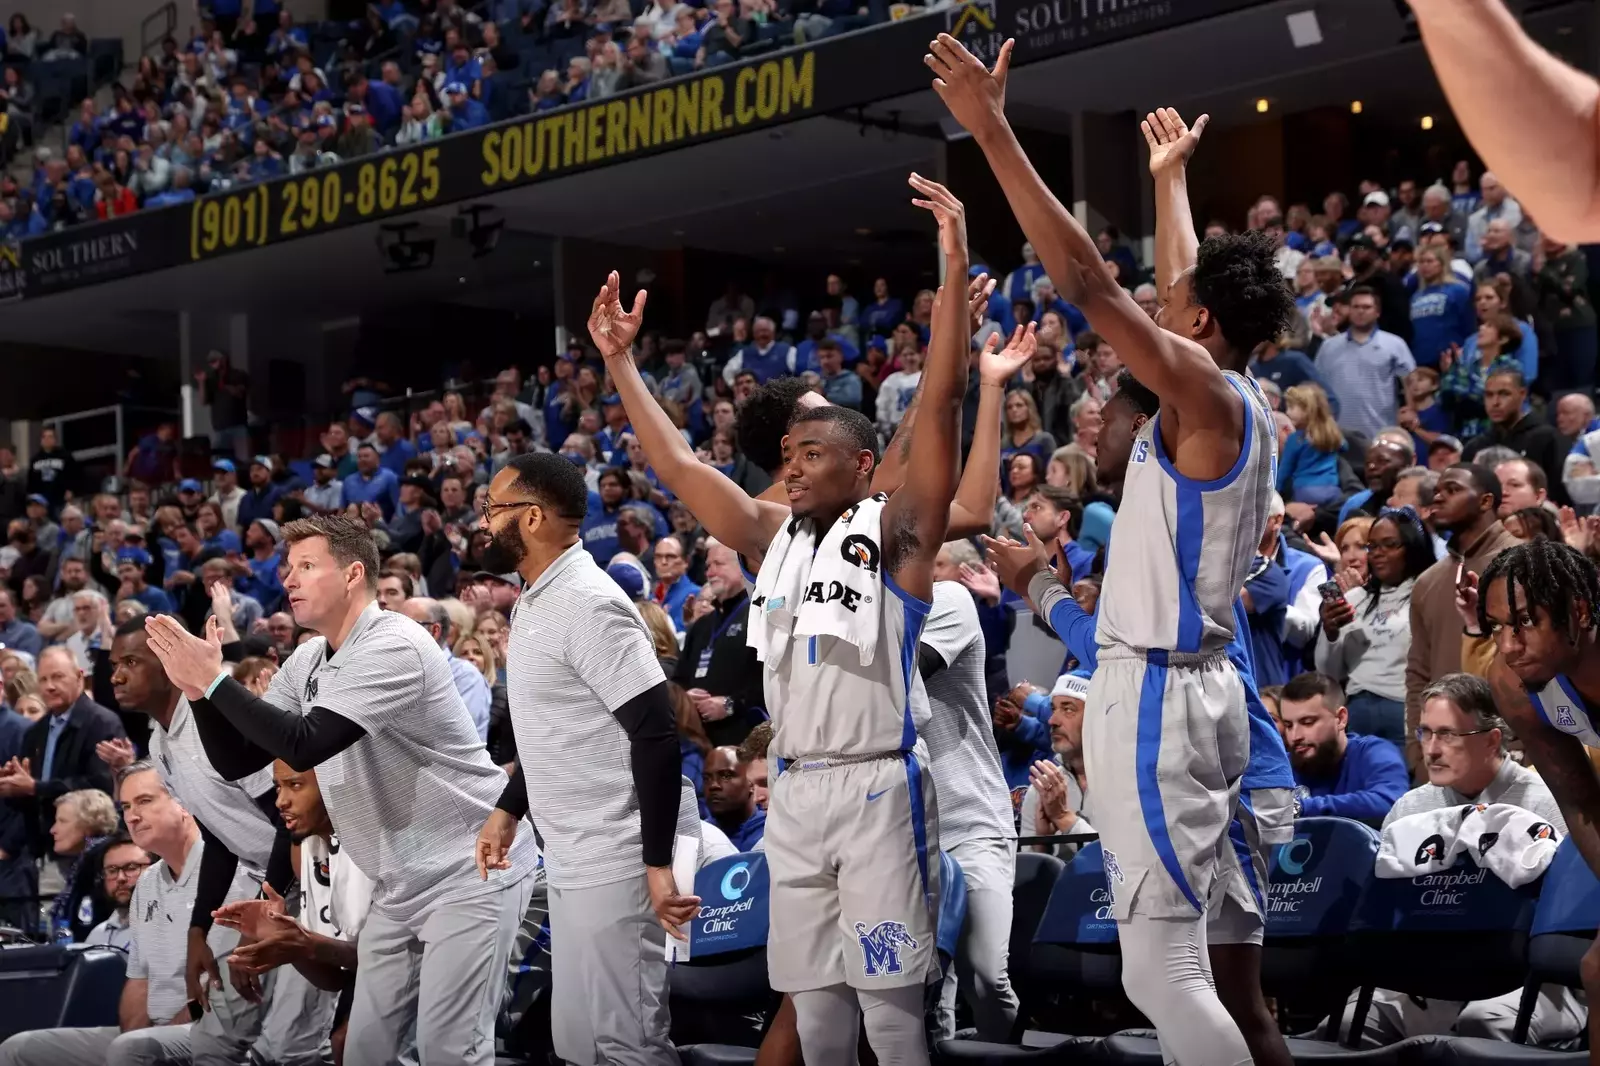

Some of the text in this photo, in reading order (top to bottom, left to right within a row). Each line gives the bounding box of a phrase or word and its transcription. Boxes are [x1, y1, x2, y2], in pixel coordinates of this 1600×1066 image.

[481, 51, 815, 186] SOUTHERNRNR.COM
[190, 147, 440, 260] (901) 290-8625
[32, 228, 138, 275] SOUTHERN
[1066, 680, 1088, 694] Tige
[1268, 876, 1323, 898] mpbell
[1411, 868, 1487, 890] Campbell
[698, 897, 755, 919] Campbell
[1420, 889, 1464, 905] Clinic
[703, 917, 737, 934] Clinic
